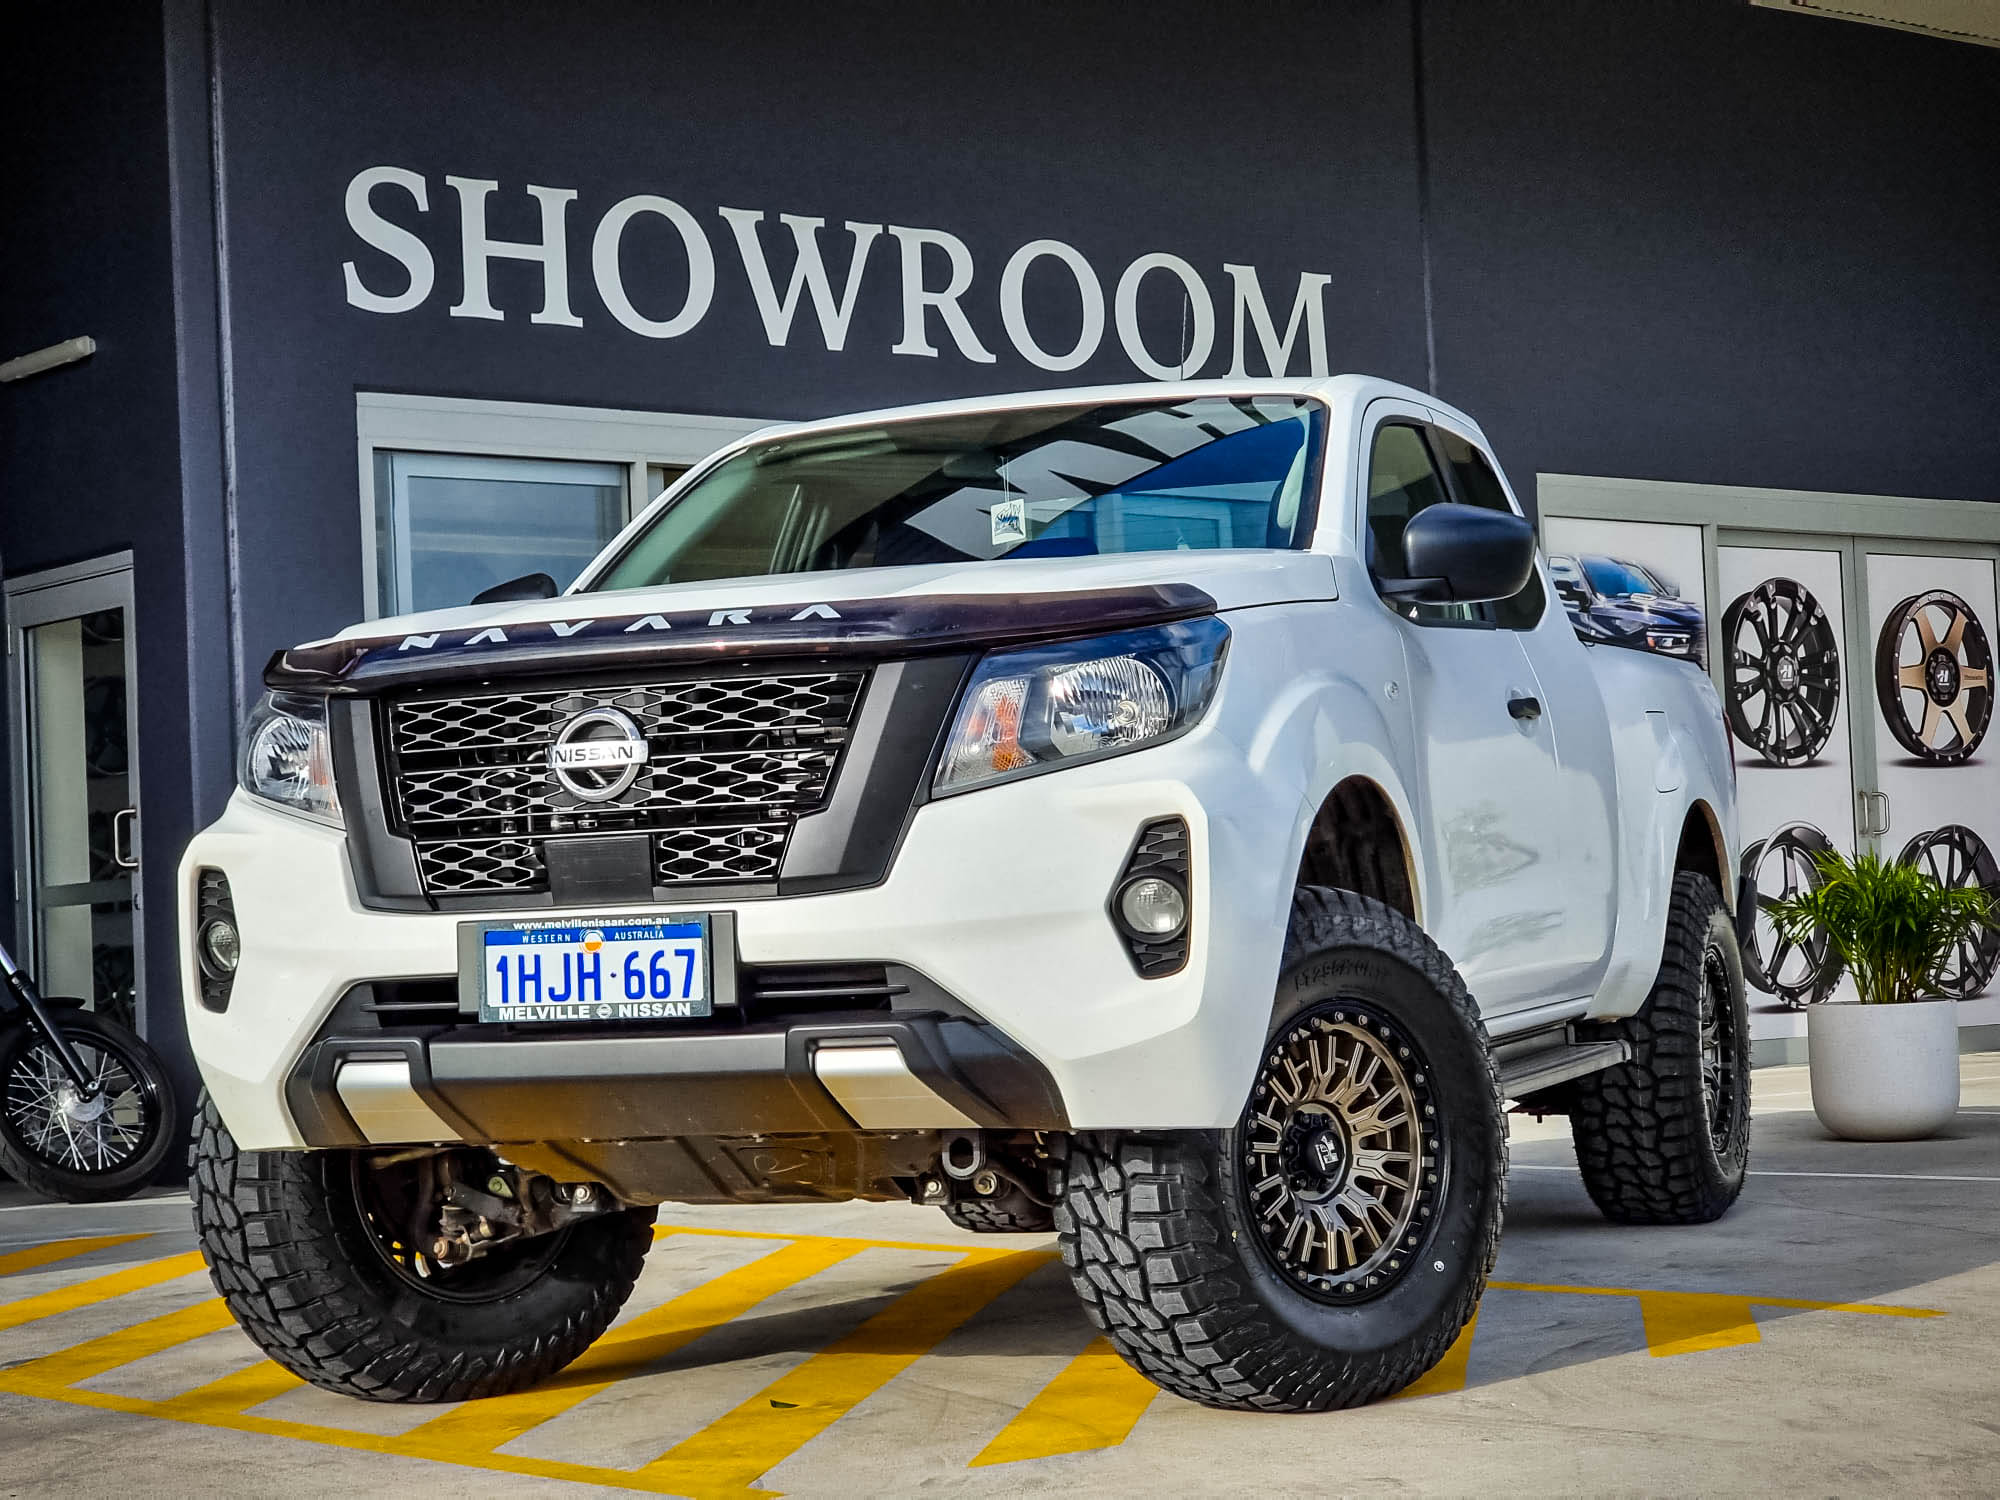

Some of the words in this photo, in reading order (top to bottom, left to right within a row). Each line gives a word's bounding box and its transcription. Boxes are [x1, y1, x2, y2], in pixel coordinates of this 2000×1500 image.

[343, 165, 1332, 379] SHOWROOM
[398, 603, 842, 651] NAVARA
[555, 745, 633, 763] NISSAN
[513, 916, 670, 930] www.melvillenissan.com.au
[522, 933, 571, 944] WESTERN
[614, 929, 665, 940] AUSTRALIA
[498, 1004, 591, 1021] MELVILLE
[618, 1002, 691, 1018] NISSAN
